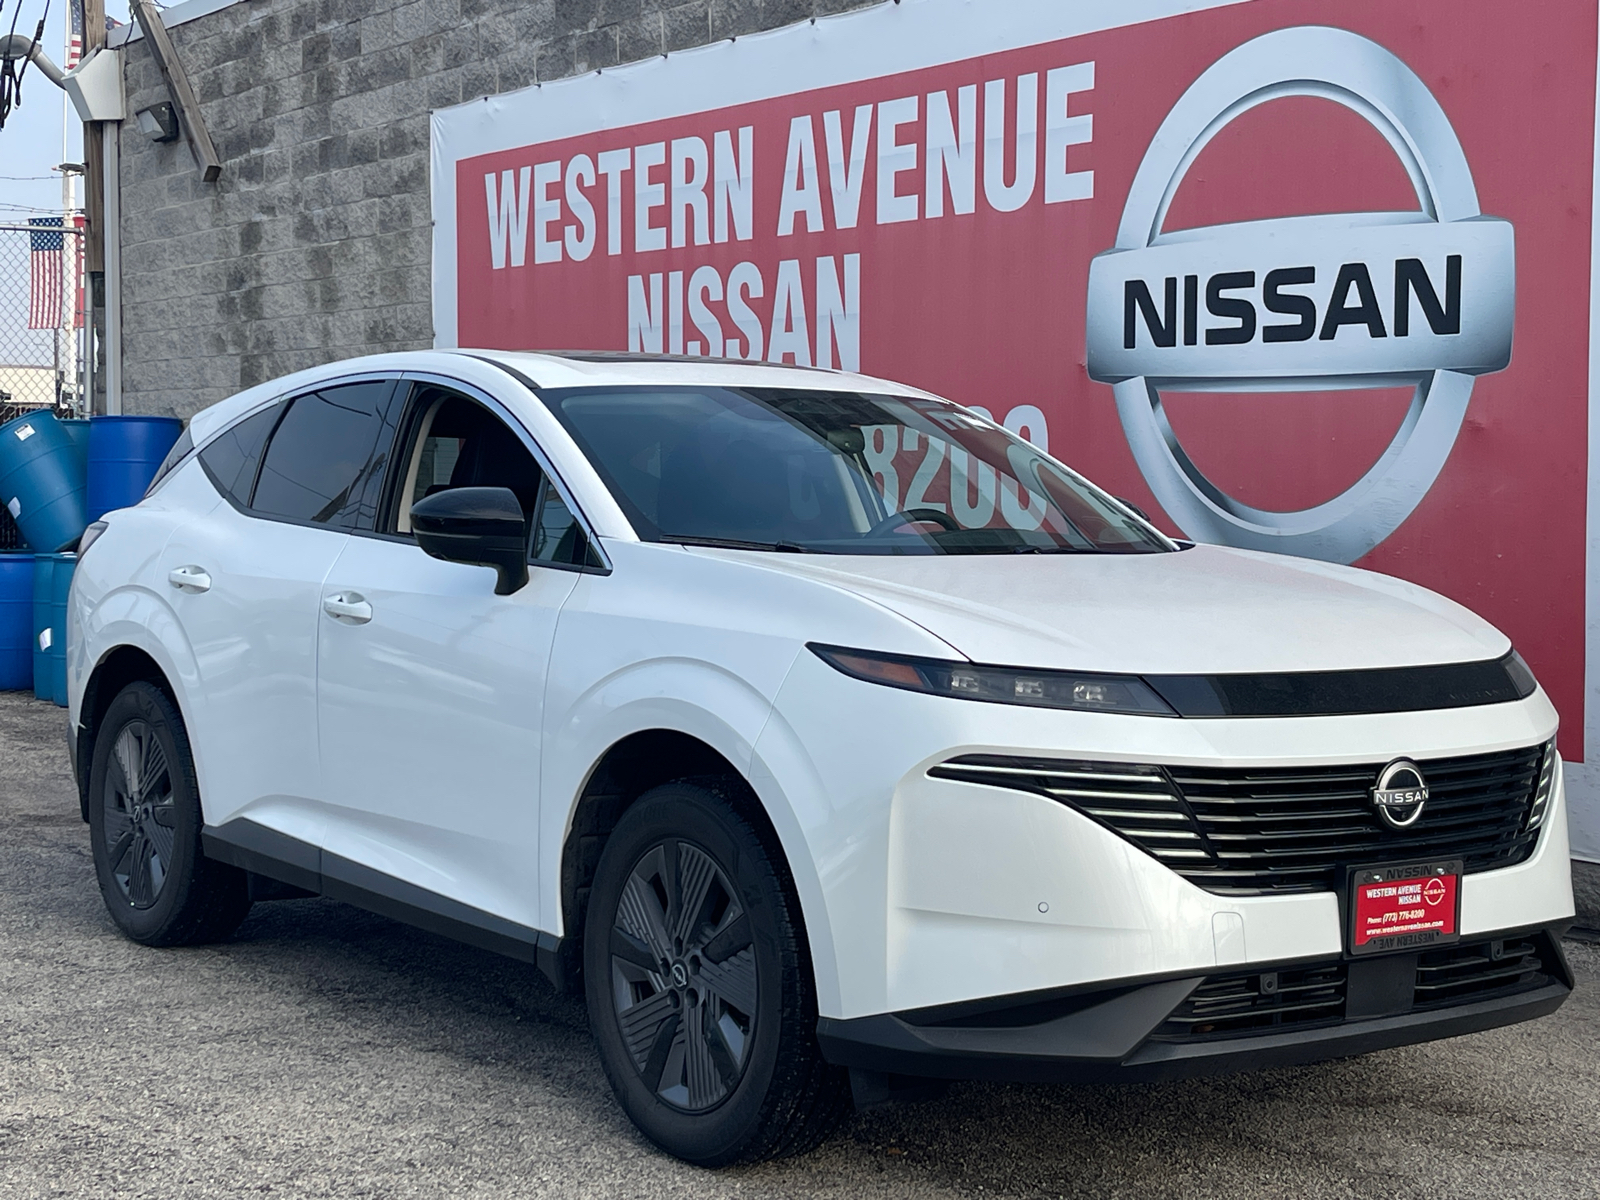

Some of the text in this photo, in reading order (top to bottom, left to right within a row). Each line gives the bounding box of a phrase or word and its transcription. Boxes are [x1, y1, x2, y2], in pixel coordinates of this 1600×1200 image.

[485, 61, 1096, 270] WESTERN AVENUE
[1123, 255, 1463, 349] NISSAN
[627, 253, 861, 373] NISSAN
[1376, 789, 1429, 804] NISSAN
[1387, 866, 1432, 880] NISSAN
[1366, 884, 1422, 898] WESTERN AVENUE
[1398, 894, 1422, 905] NISSAN
